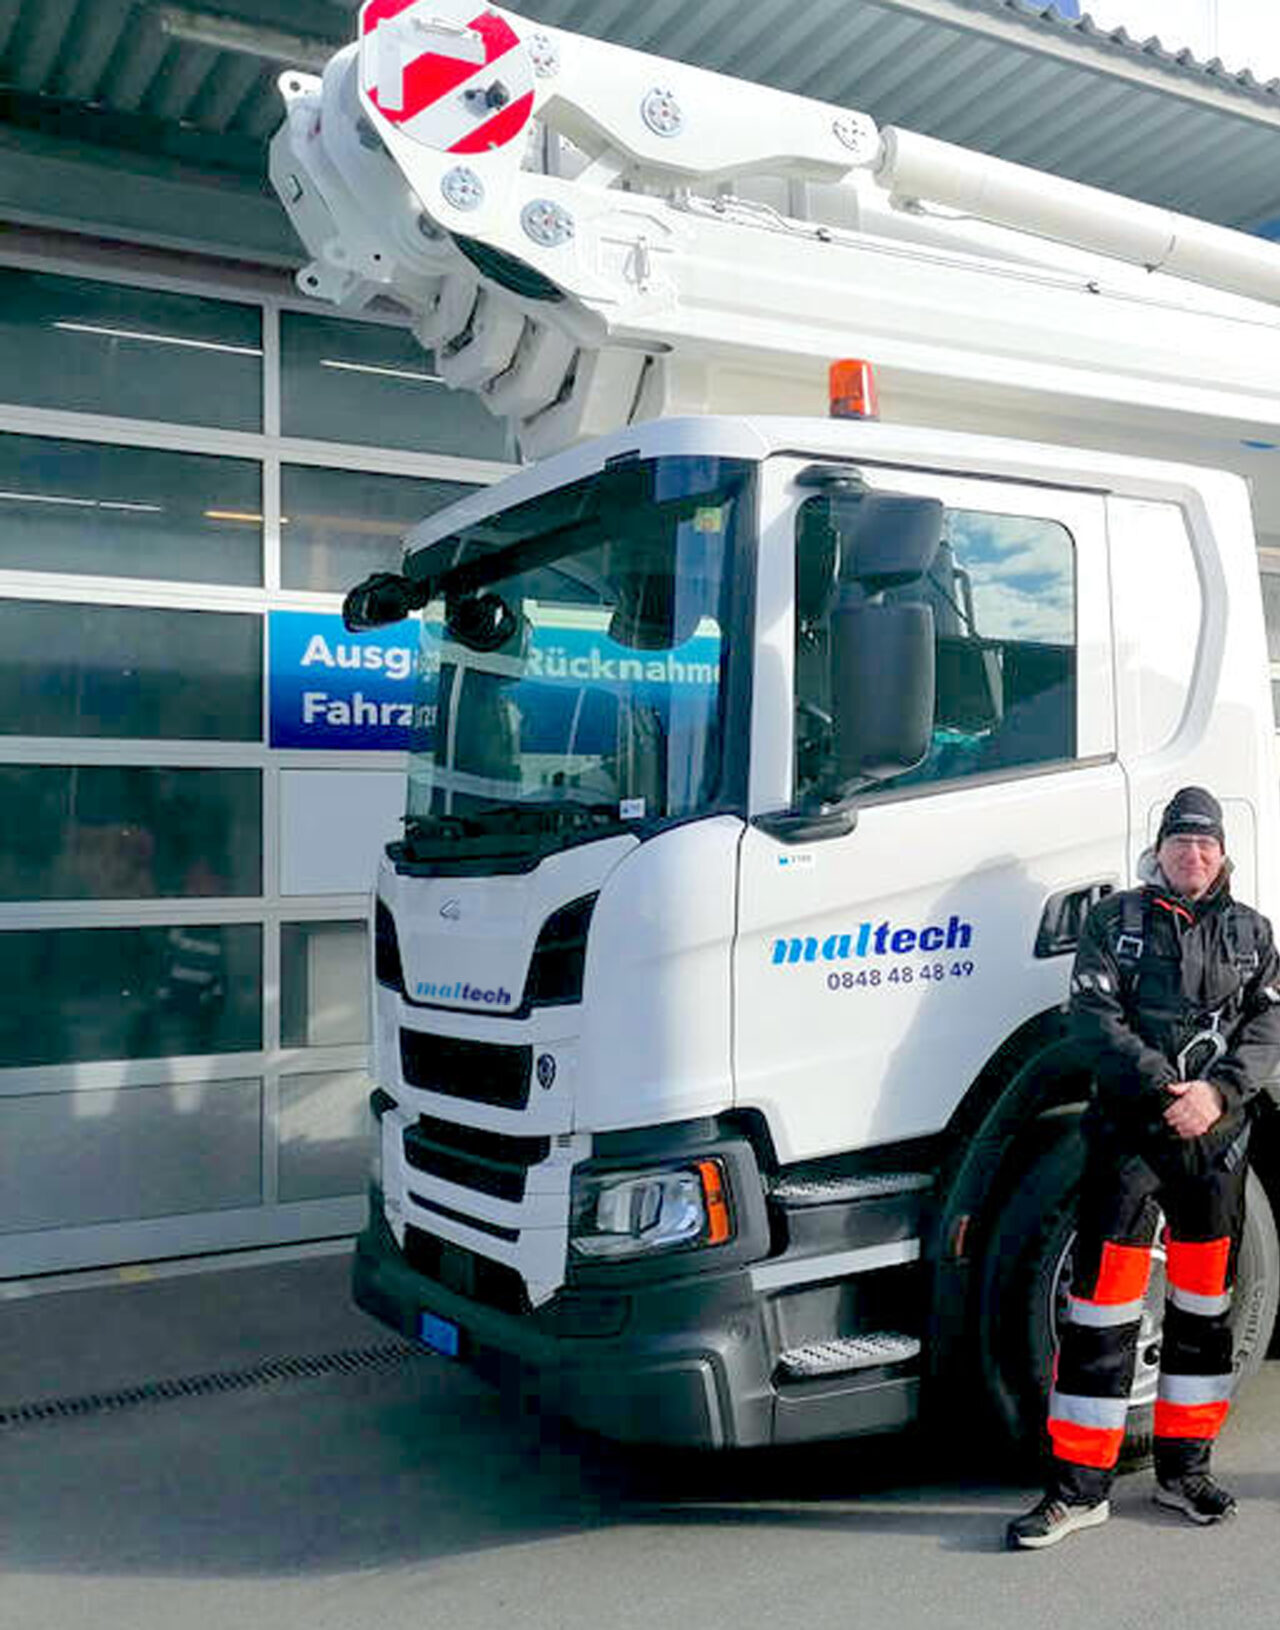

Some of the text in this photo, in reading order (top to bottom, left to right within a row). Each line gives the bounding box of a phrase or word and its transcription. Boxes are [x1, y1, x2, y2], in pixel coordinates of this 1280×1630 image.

[300, 634, 720, 684] Ausg Rücknahm
[302, 691, 438, 727] Fahrz
[771, 915, 973, 965] maltech
[416, 982, 511, 1005] maltech
[827, 961, 975, 991] 0848 48 48 49
